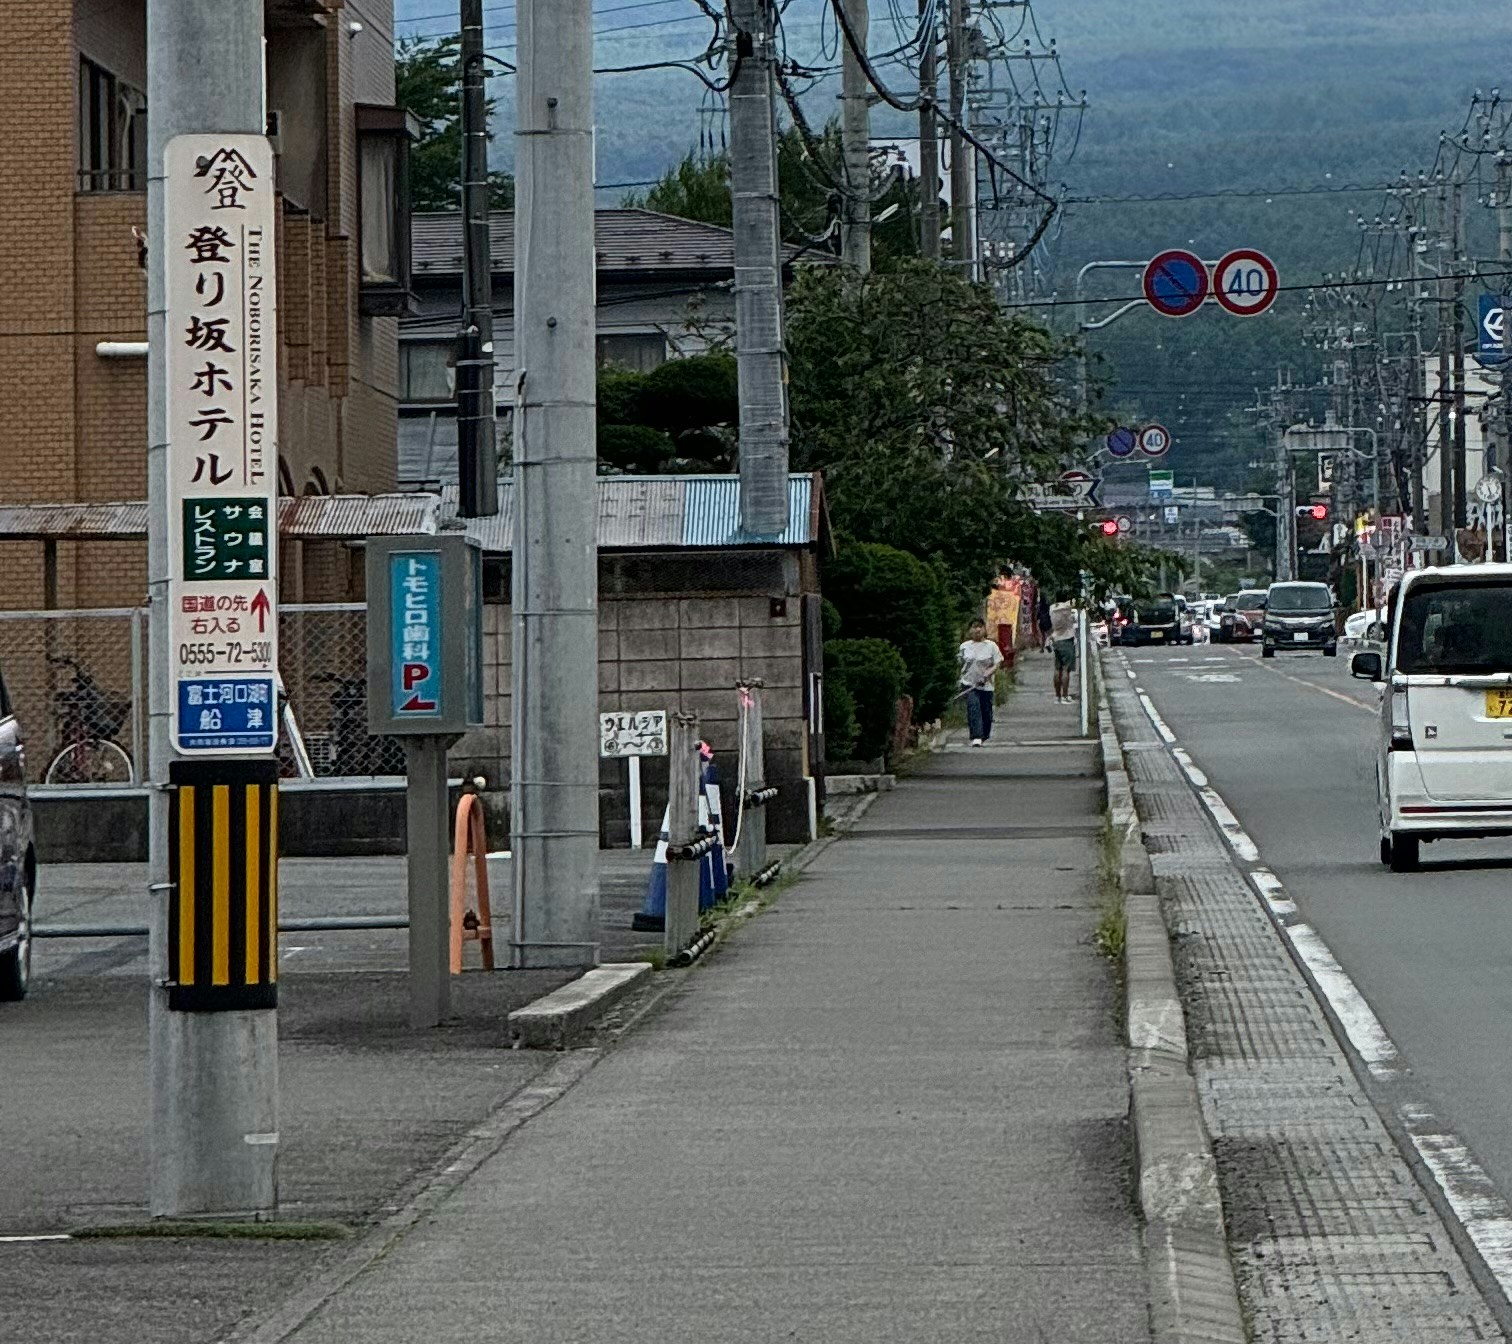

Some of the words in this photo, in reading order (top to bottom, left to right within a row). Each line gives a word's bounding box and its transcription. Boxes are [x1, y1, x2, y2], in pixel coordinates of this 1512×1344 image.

[248, 225, 263, 268] THE
[1229, 268, 1263, 297] 40
[184, 225, 238, 487] 登り坂ホテル
[248, 275, 264, 405] NOBORISAKA
[249, 412, 264, 486] HOTEL
[1146, 432, 1163, 448] 40
[193, 505, 217, 574] レストラン
[222, 505, 244, 574] サウナ
[181, 595, 249, 612] 国道の先
[190, 617, 241, 634] 右入る
[402, 559, 431, 661] トモヒロ歯科
[403, 663, 429, 691] P
